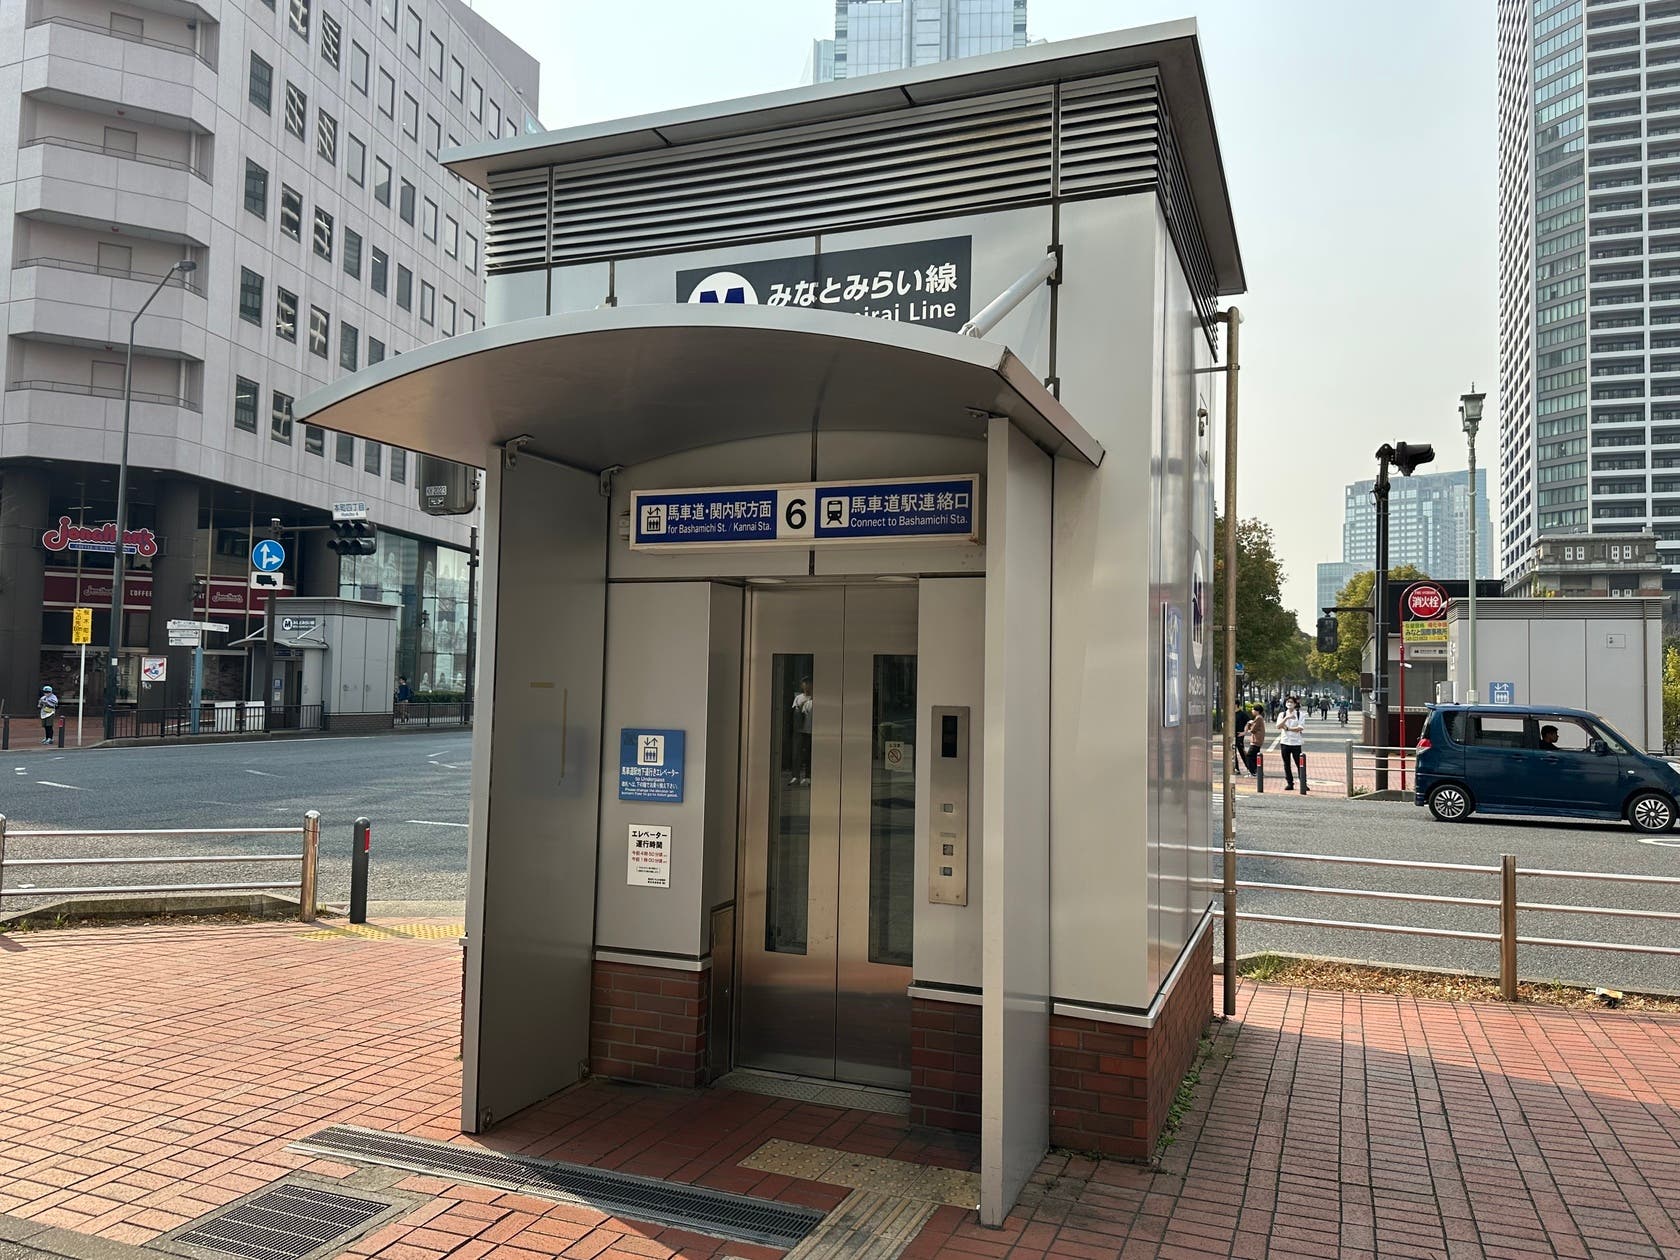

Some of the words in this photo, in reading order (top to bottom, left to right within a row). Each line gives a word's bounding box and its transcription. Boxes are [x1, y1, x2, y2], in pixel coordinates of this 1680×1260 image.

[767, 263, 957, 307] みなとみらい線
[909, 301, 956, 325] Line
[668, 501, 772, 521] 馬車道・関内駅方面
[851, 492, 969, 514] 馬車道駅連絡口
[786, 498, 806, 530] 6
[851, 516, 886, 528] Connect
[888, 516, 897, 526] to
[899, 513, 948, 525] Bashamichi
[950, 513, 968, 524] Sta.
[668, 525, 678, 535] for
[679, 523, 716, 534] Bashamichi
[717, 522, 726, 532] St.
[733, 521, 757, 532] Kannai
[758, 521, 772, 531] Sta.
[1412, 596, 1439, 608] 消火栓
[632, 831, 668, 839] エレベーター
[636, 840, 663, 849] 運行時間
